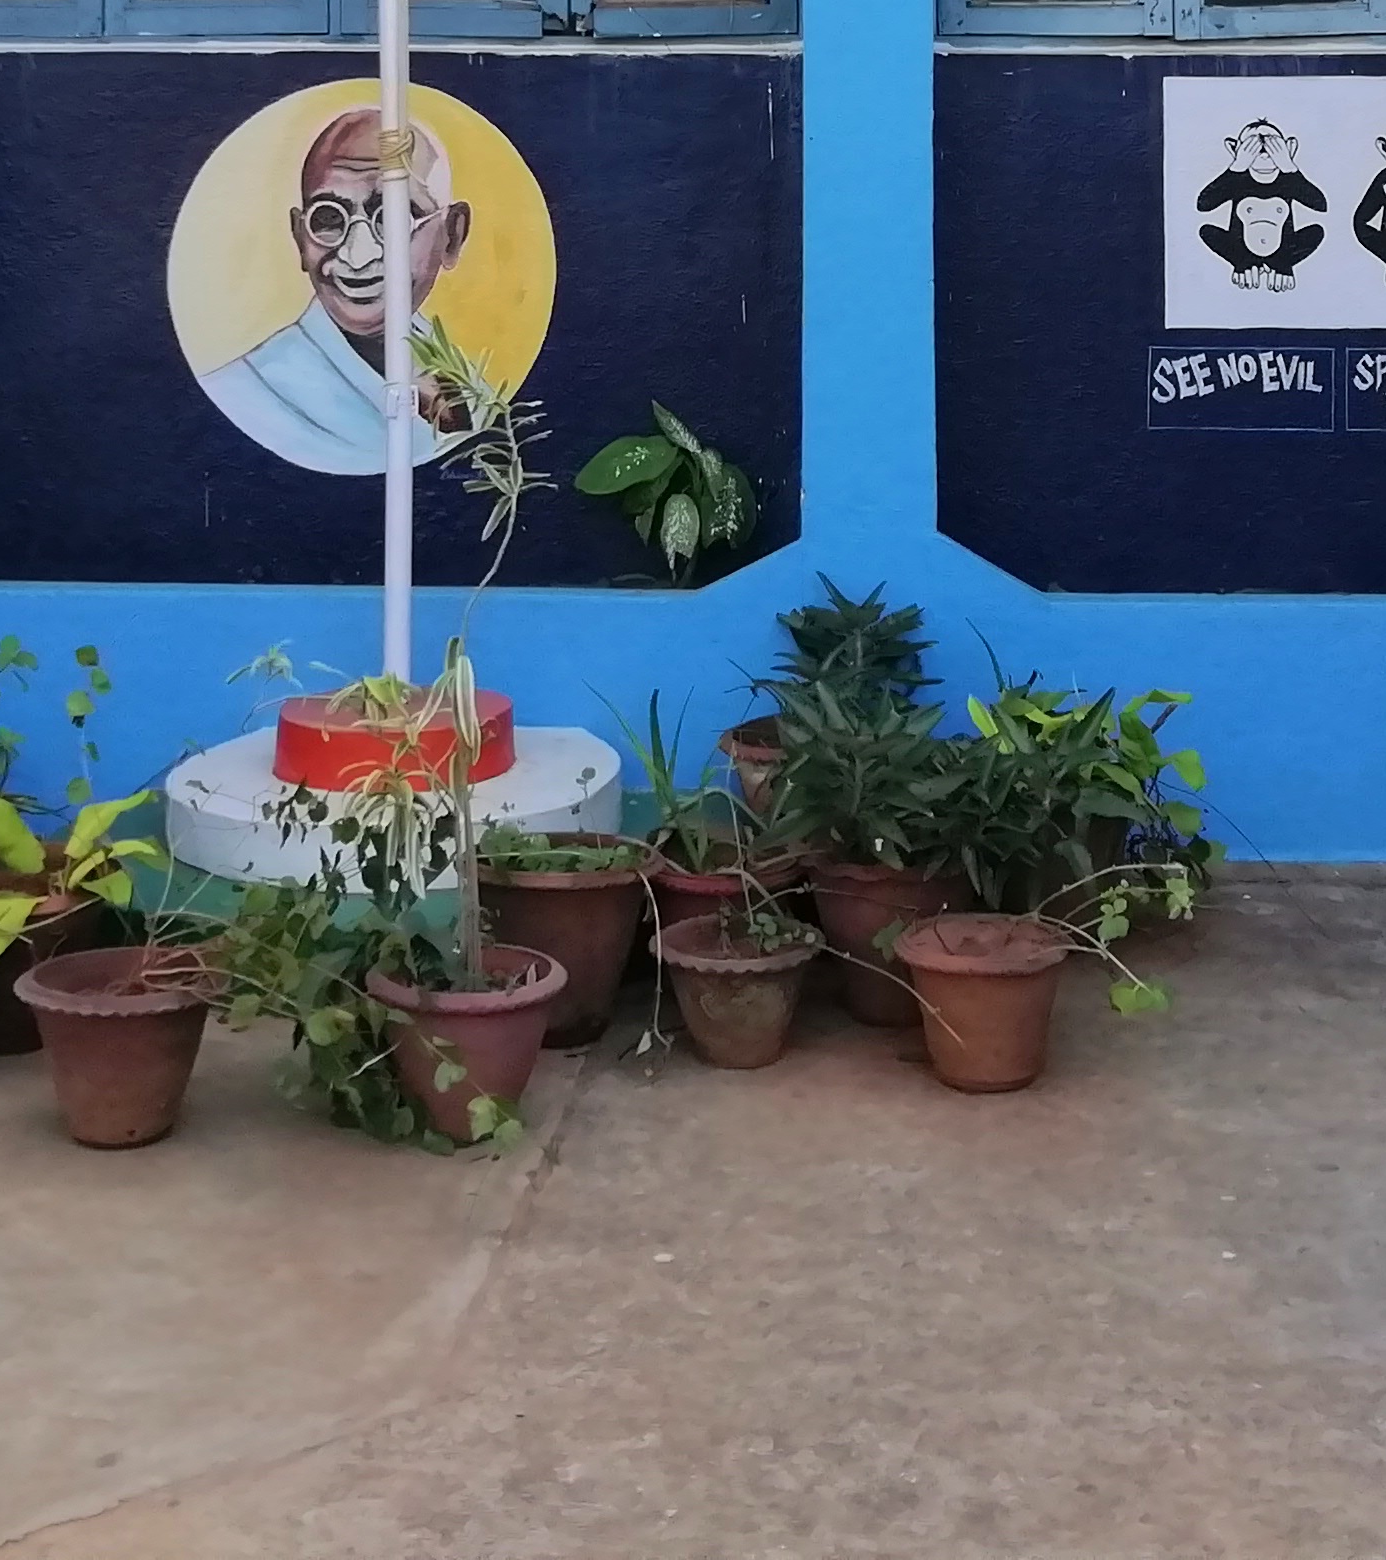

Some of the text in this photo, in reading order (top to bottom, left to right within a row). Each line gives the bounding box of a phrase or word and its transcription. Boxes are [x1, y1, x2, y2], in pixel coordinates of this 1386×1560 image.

[1151, 350, 1323, 404] SEE NO EVIL
